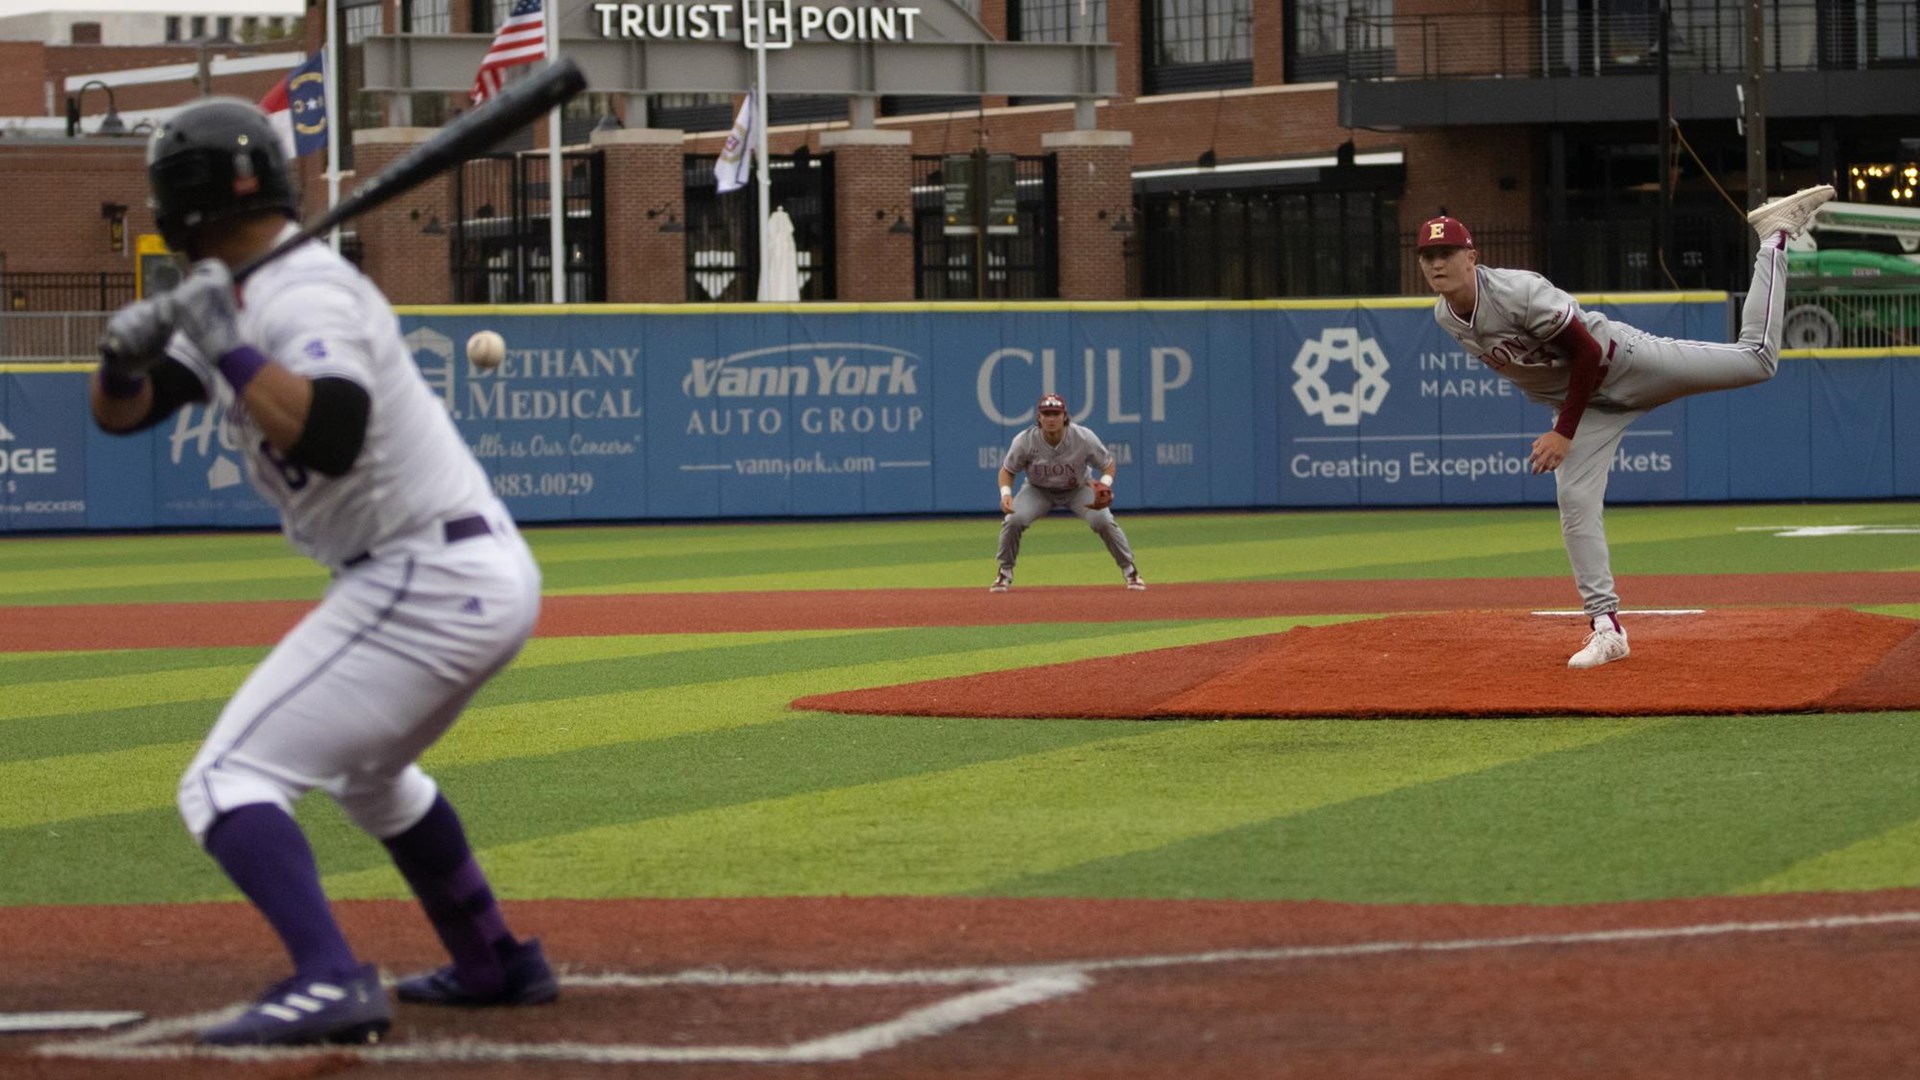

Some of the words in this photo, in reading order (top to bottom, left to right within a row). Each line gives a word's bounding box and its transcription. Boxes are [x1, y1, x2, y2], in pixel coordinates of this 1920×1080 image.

[595, 3, 733, 38] TRUIST
[801, 6, 921, 40] POINT
[1429, 223, 1445, 240] E
[1420, 352, 1487, 370] INTE
[467, 380, 642, 420] MEDICAL
[976, 347, 1193, 426] CULP
[1421, 379, 1513, 397] MARKE
[687, 409, 782, 435] AUTO
[801, 406, 922, 433] GROUP
[1291, 453, 1400, 483] Creating
[1611, 447, 1672, 472] rkets
